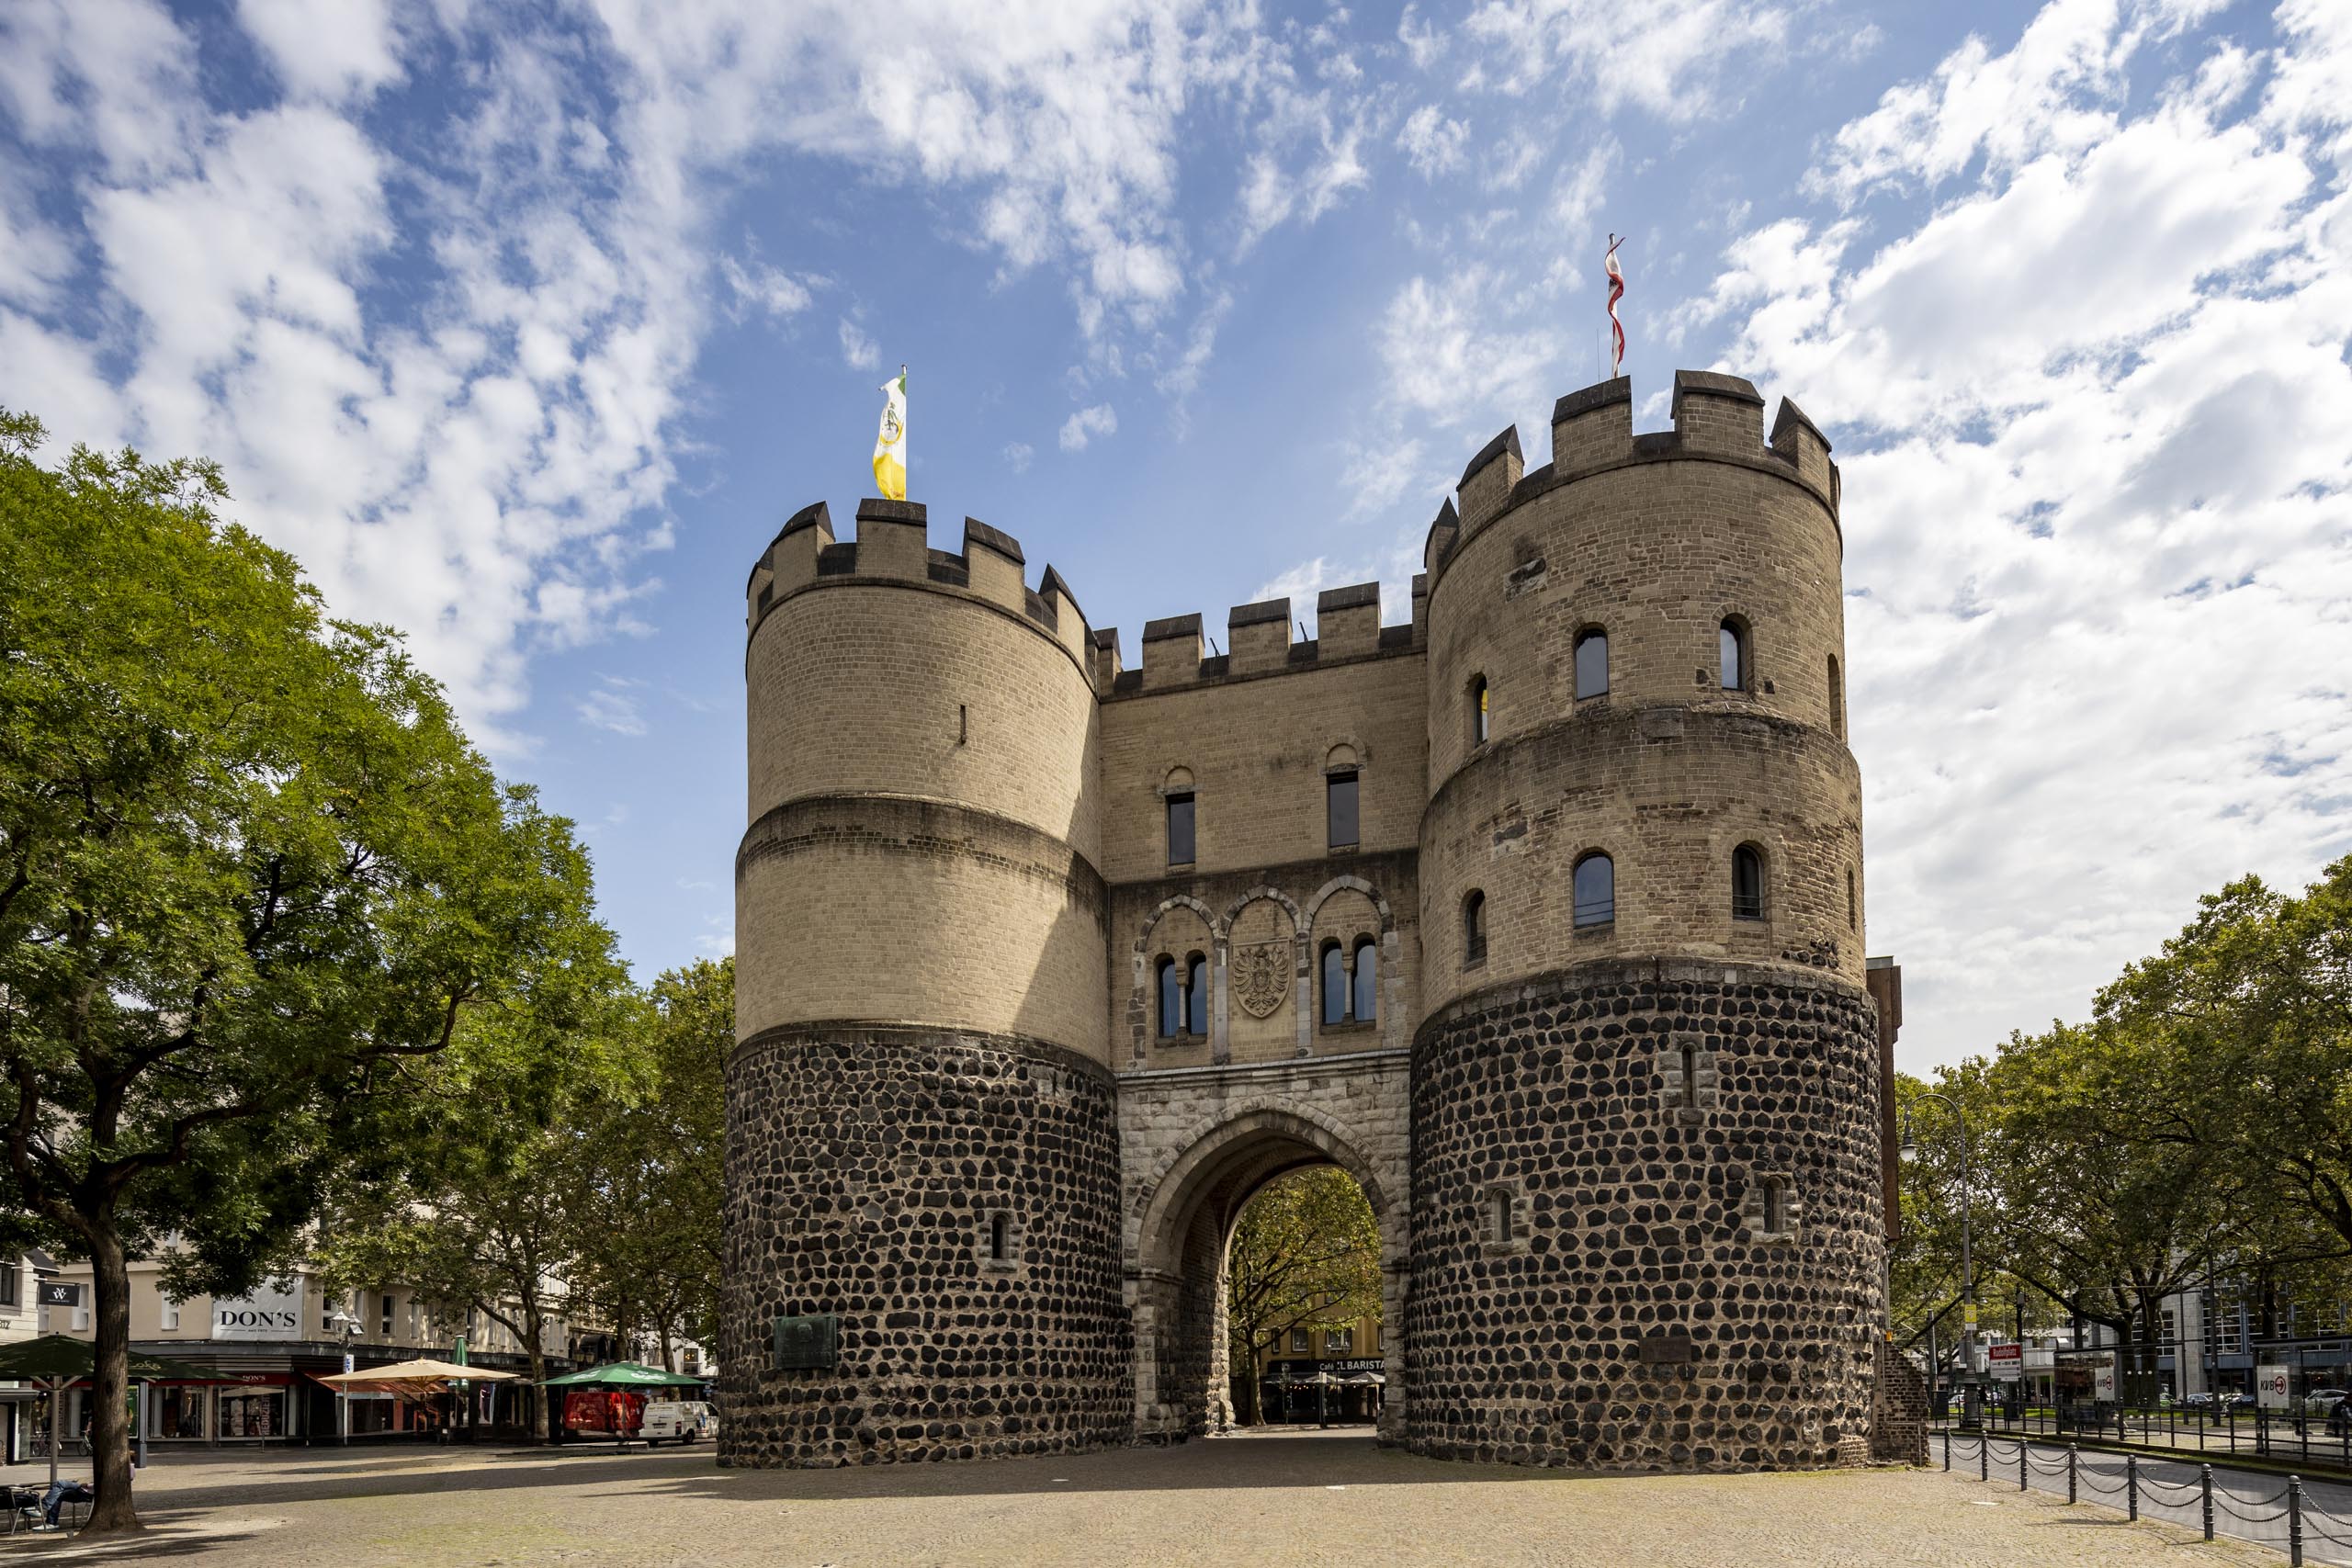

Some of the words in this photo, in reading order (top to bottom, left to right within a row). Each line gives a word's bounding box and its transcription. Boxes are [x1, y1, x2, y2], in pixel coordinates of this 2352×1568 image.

[220, 1311, 296, 1327] DON'S
[1347, 1360, 1385, 1371] BARISTA
[2260, 1380, 2275, 1391] KVB
